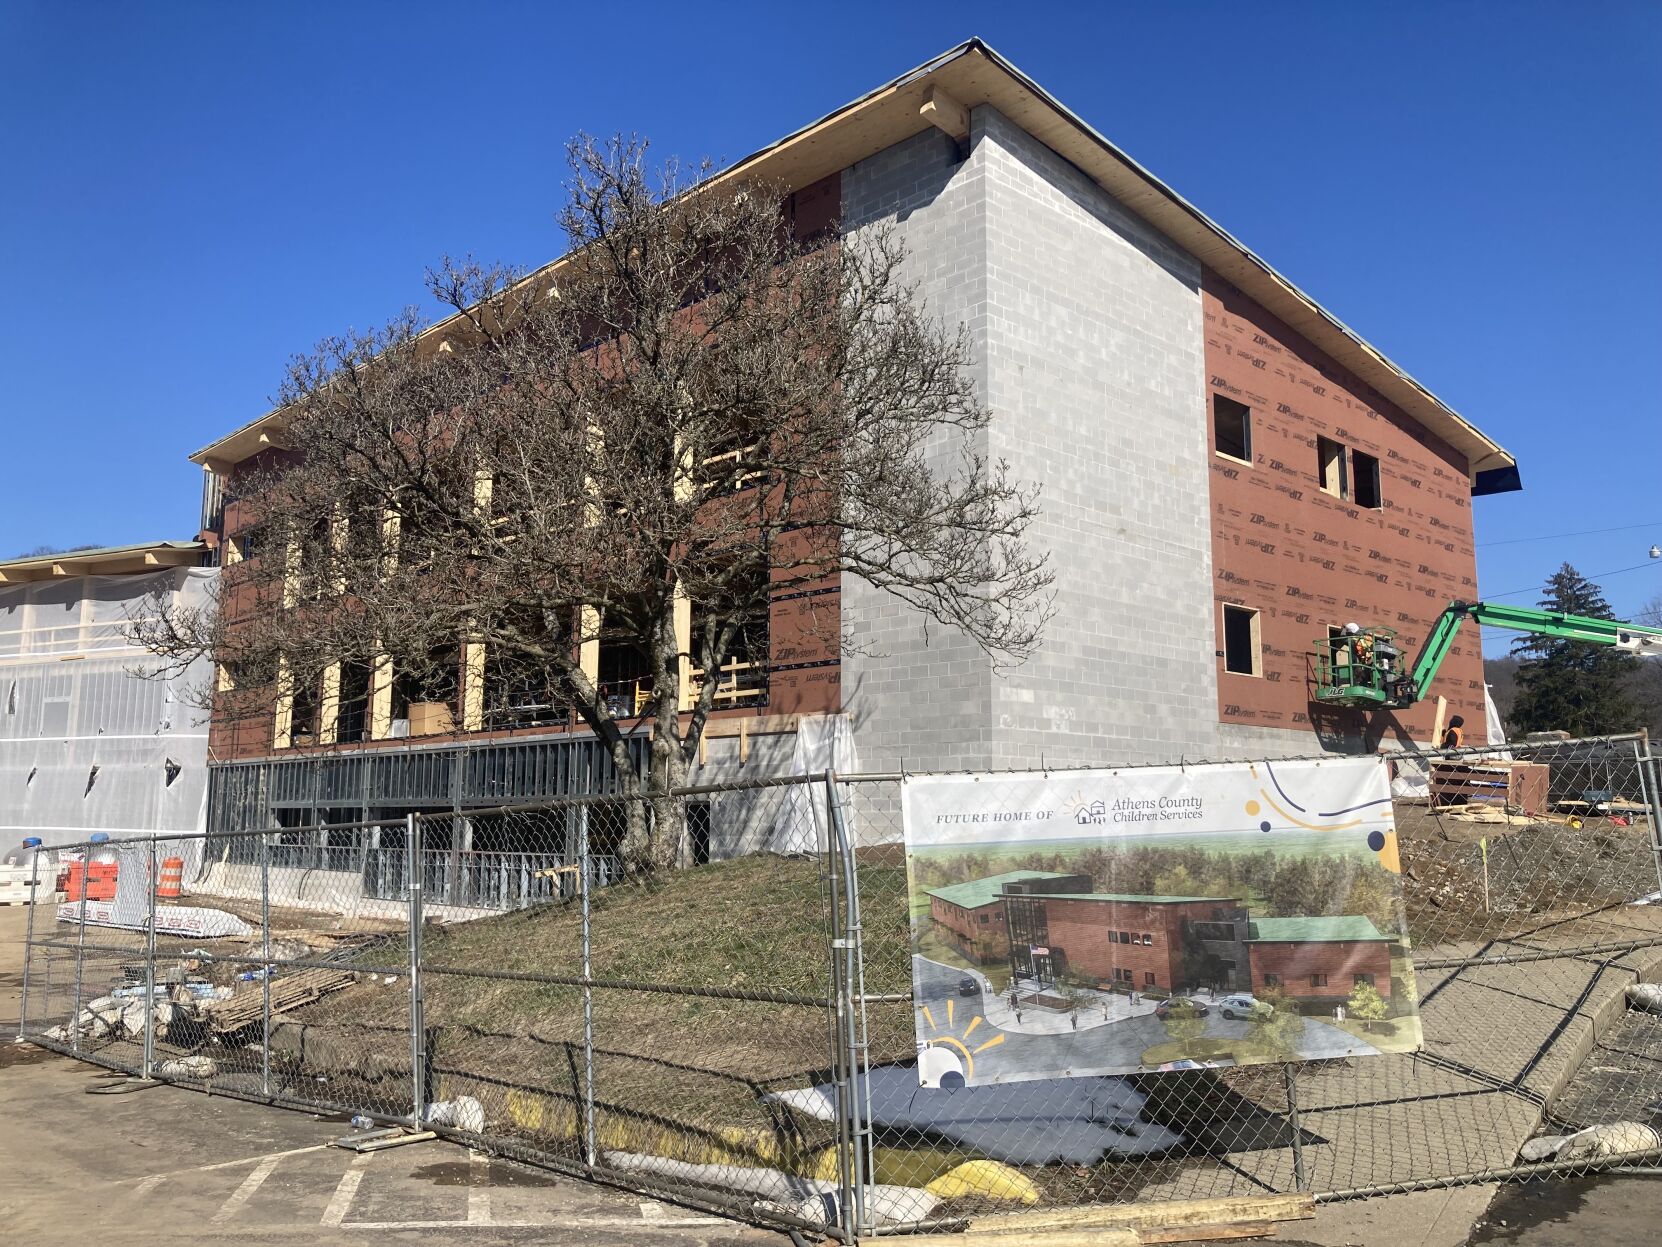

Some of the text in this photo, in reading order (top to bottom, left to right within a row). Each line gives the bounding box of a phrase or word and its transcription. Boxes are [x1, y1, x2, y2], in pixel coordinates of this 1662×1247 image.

[1328, 687, 1345, 696] JLG
[1111, 796, 1202, 810] Athens County
[936, 810, 1054, 824] FUTURE HOME OF
[1113, 809, 1203, 822] Children Services
